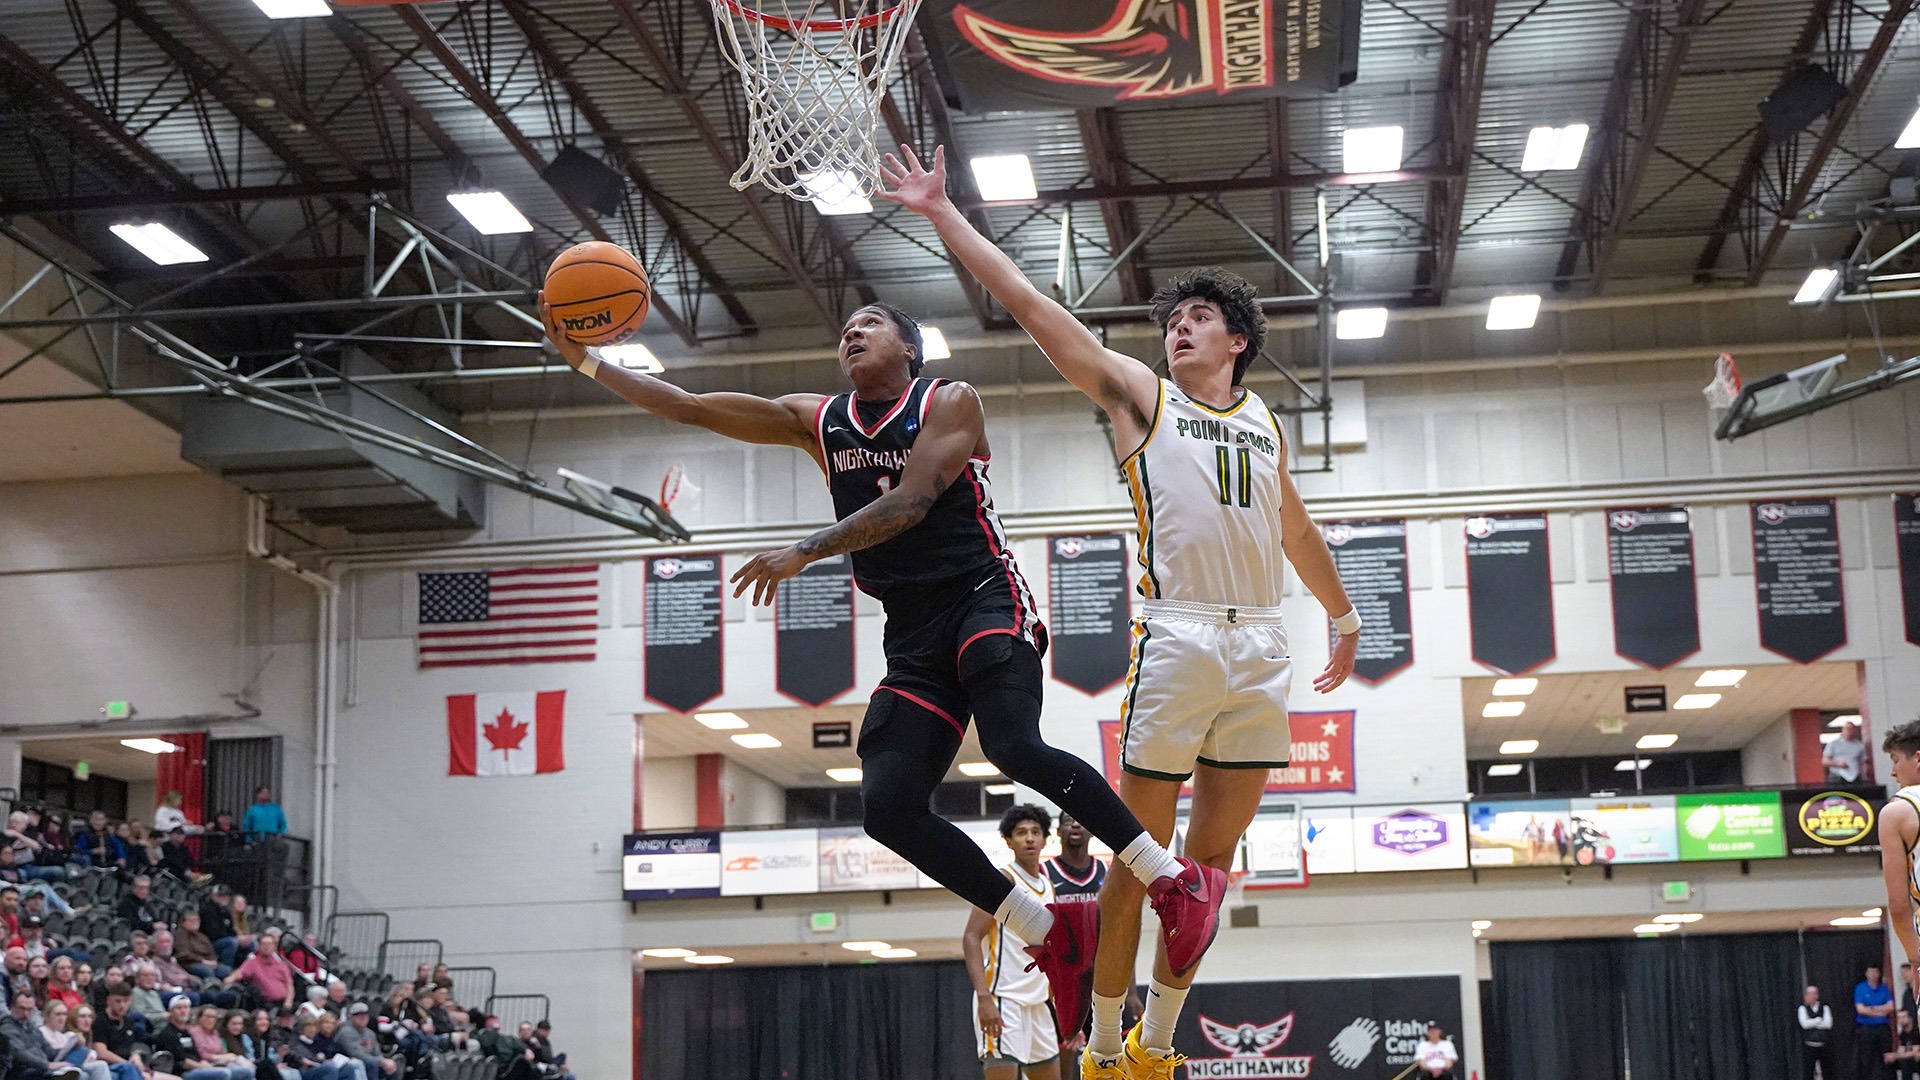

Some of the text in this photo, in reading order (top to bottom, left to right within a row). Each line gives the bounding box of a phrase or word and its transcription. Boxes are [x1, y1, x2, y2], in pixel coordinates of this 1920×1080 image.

[563, 311, 613, 331] NCAA
[832, 447, 912, 474] NIGHTHAW
[1215, 445, 1252, 508] 11
[1806, 815, 1867, 831] PIZZA
[633, 838, 711, 851] ANDY CURRY
[1055, 892, 1099, 903] NIGHTHAW
[1190, 1060, 1306, 1077] NIGHTHAWKS
